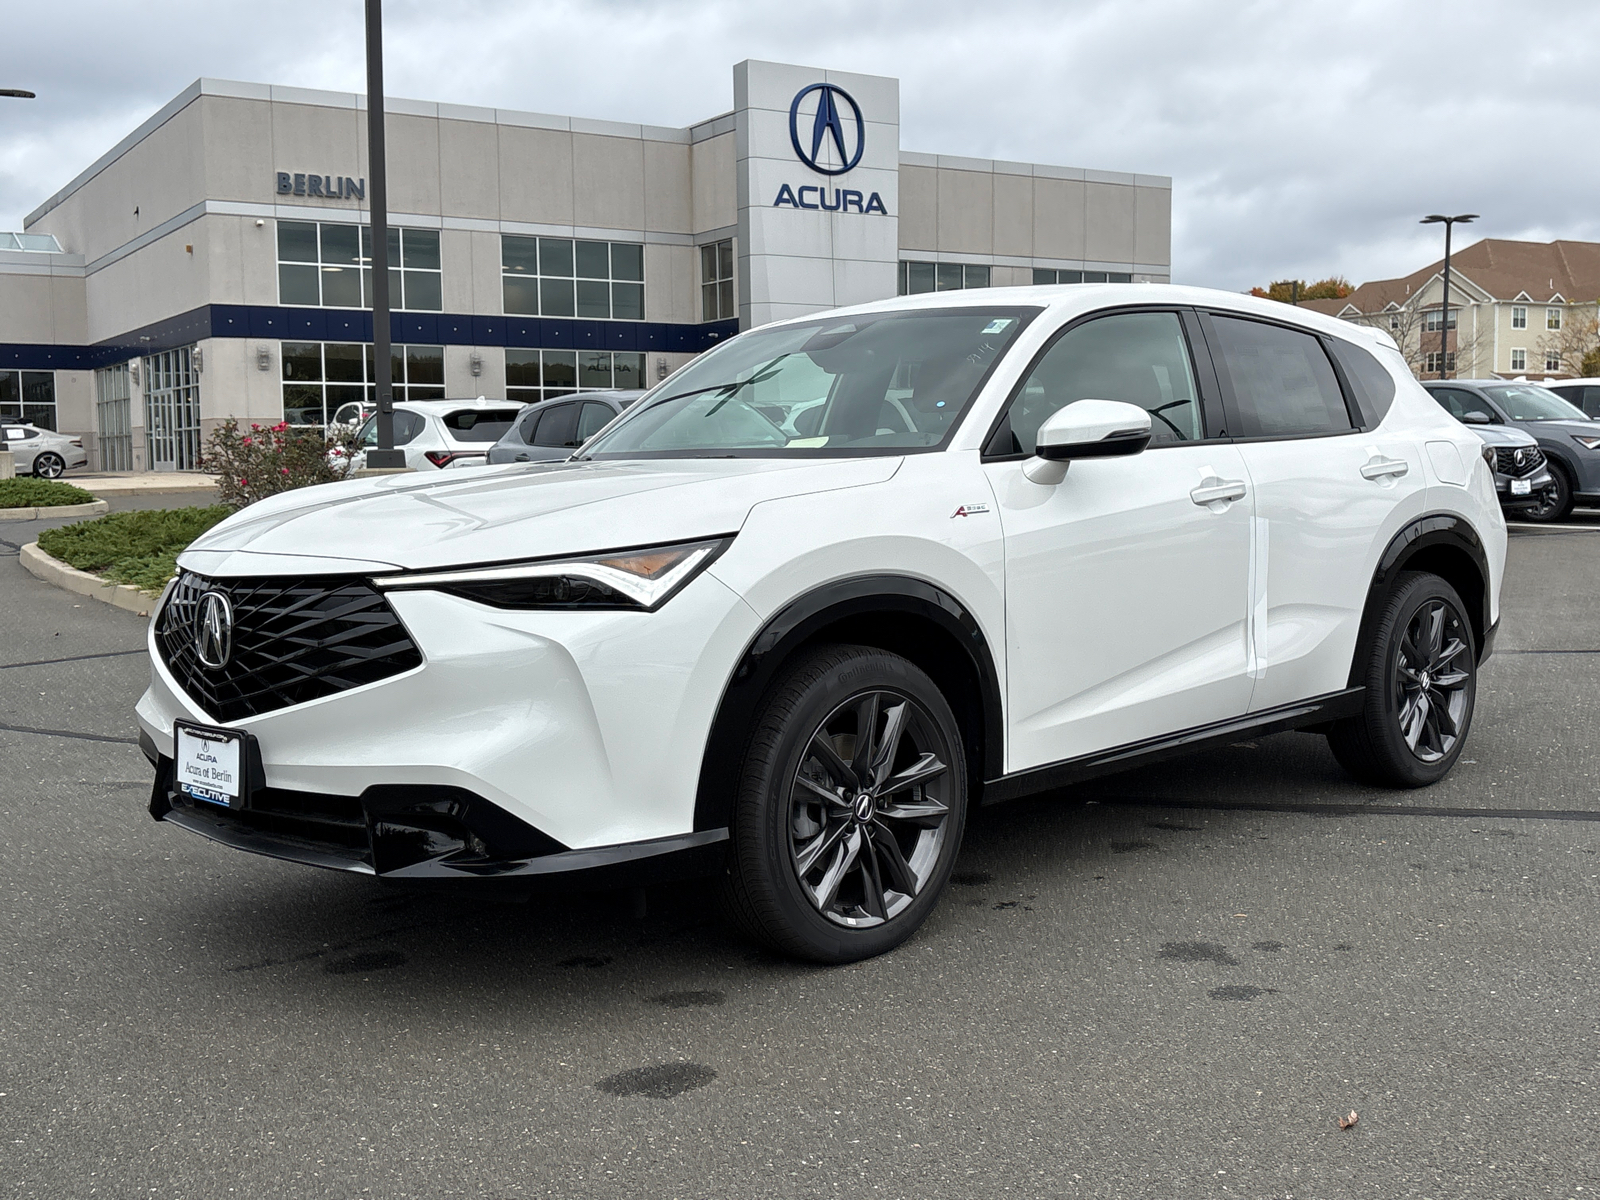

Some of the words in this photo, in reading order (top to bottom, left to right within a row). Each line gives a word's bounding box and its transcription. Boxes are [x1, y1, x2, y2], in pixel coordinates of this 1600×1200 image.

[276, 171, 365, 200] BERLIN
[773, 183, 888, 215] ACURA
[196, 752, 218, 764] ACURA
[185, 761, 202, 776] Acura
[202, 767, 210, 779] of
[211, 768, 232, 783] Berlin
[181, 783, 230, 804] EXECUTIVE
